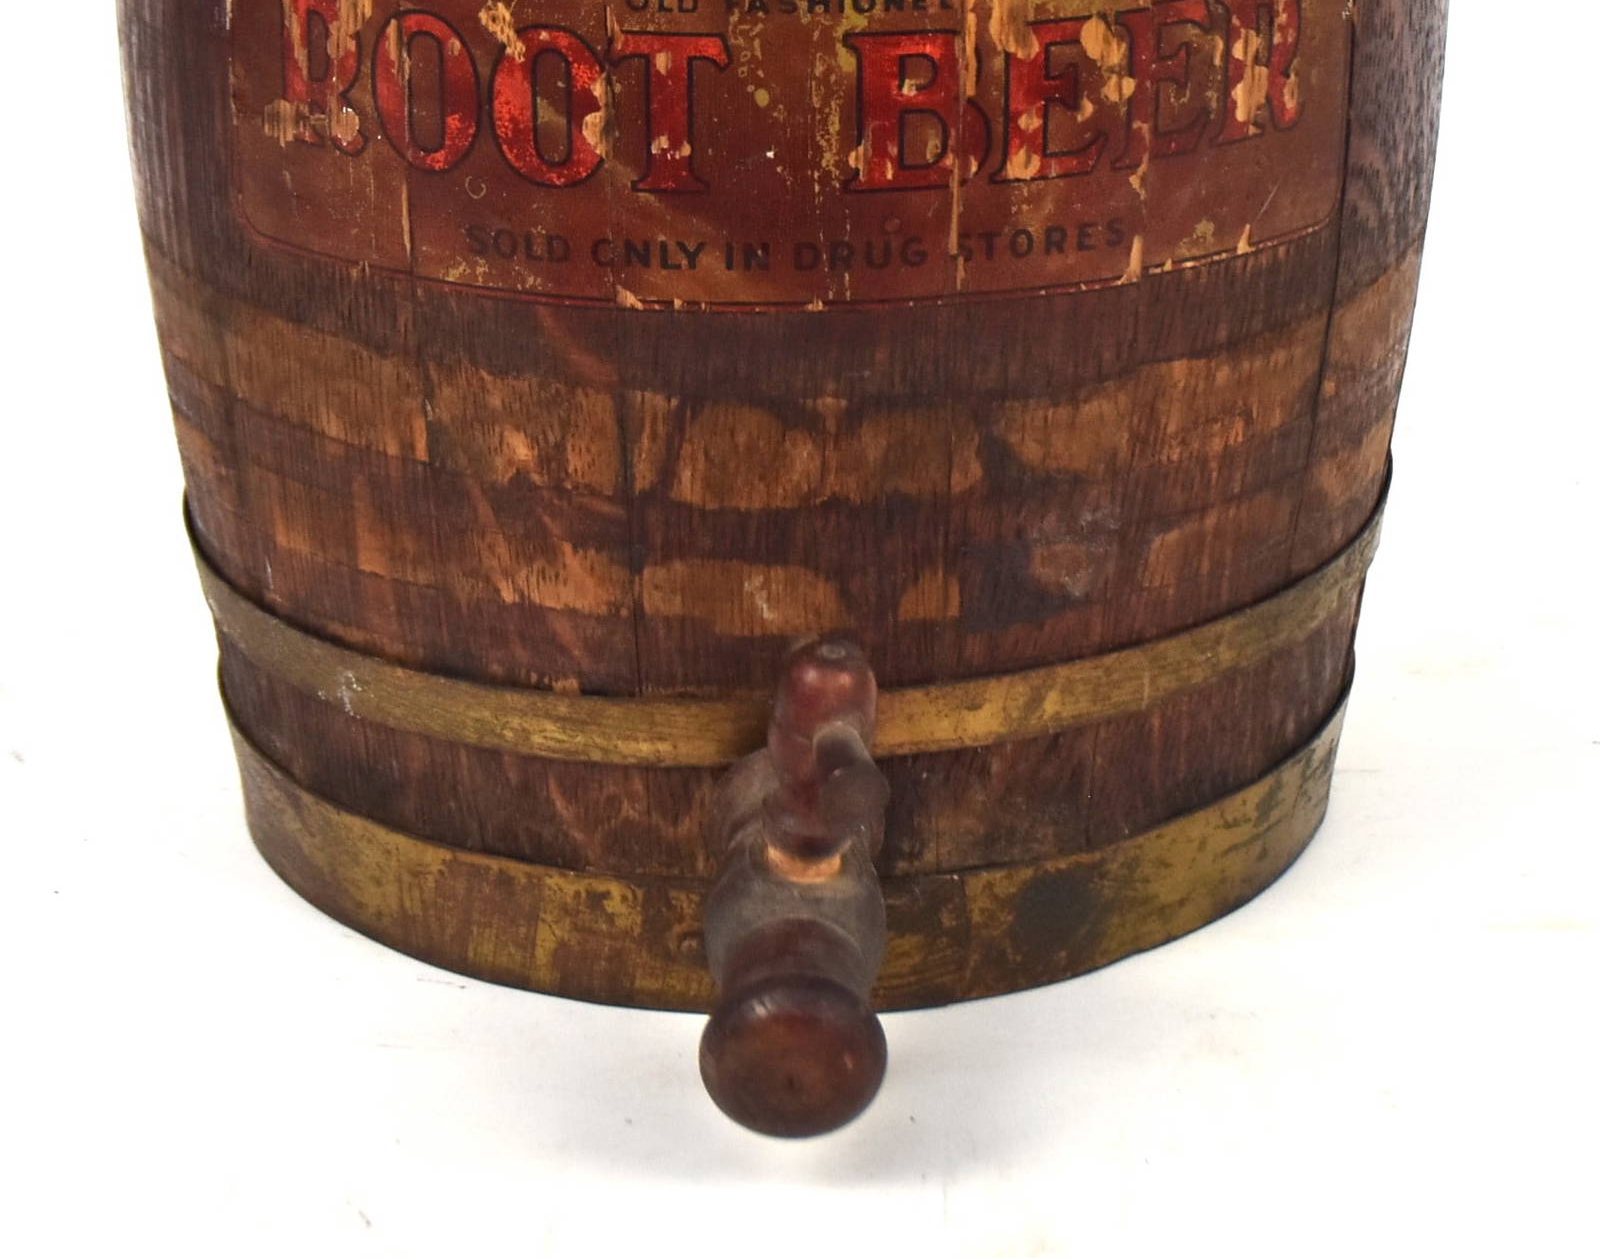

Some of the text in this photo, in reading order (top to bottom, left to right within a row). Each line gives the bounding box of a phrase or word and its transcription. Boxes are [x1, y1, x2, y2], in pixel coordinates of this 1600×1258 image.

[465, 224, 571, 264] SOLD
[724, 241, 771, 272] IN
[793, 235, 929, 272] DRUG
